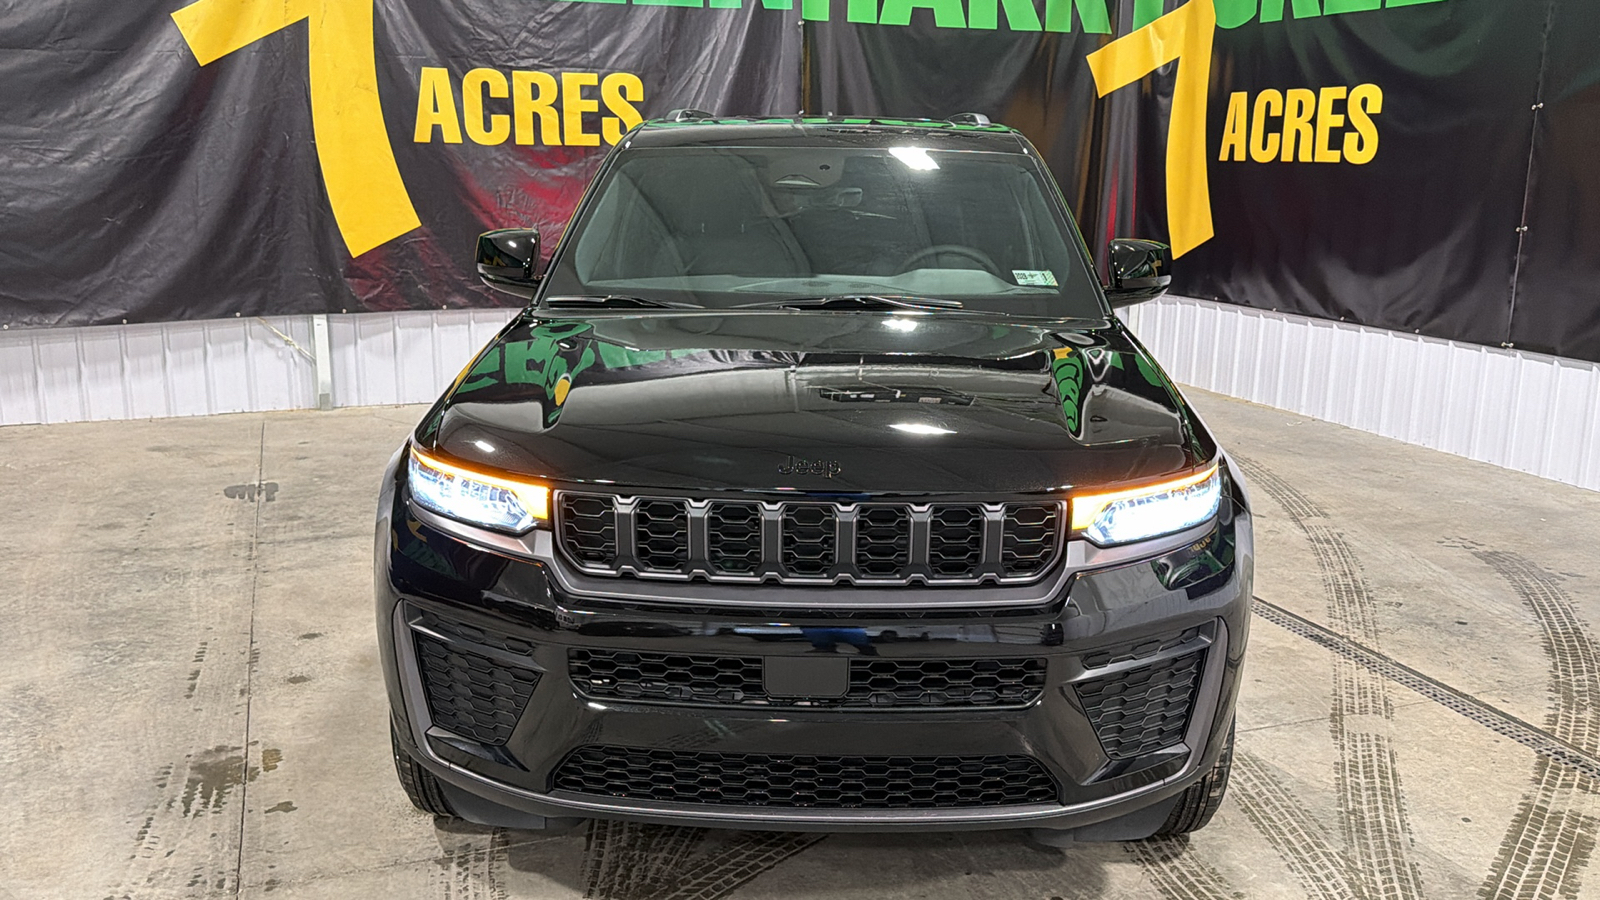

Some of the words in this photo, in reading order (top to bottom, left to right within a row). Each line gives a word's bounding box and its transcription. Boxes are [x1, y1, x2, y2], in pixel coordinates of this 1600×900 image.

[171, 0, 421, 258] 7
[414, 67, 644, 147] ACRES
[1087, 0, 1216, 260] 7
[1219, 84, 1383, 164] ACRES
[778, 455, 841, 479] Jeep
